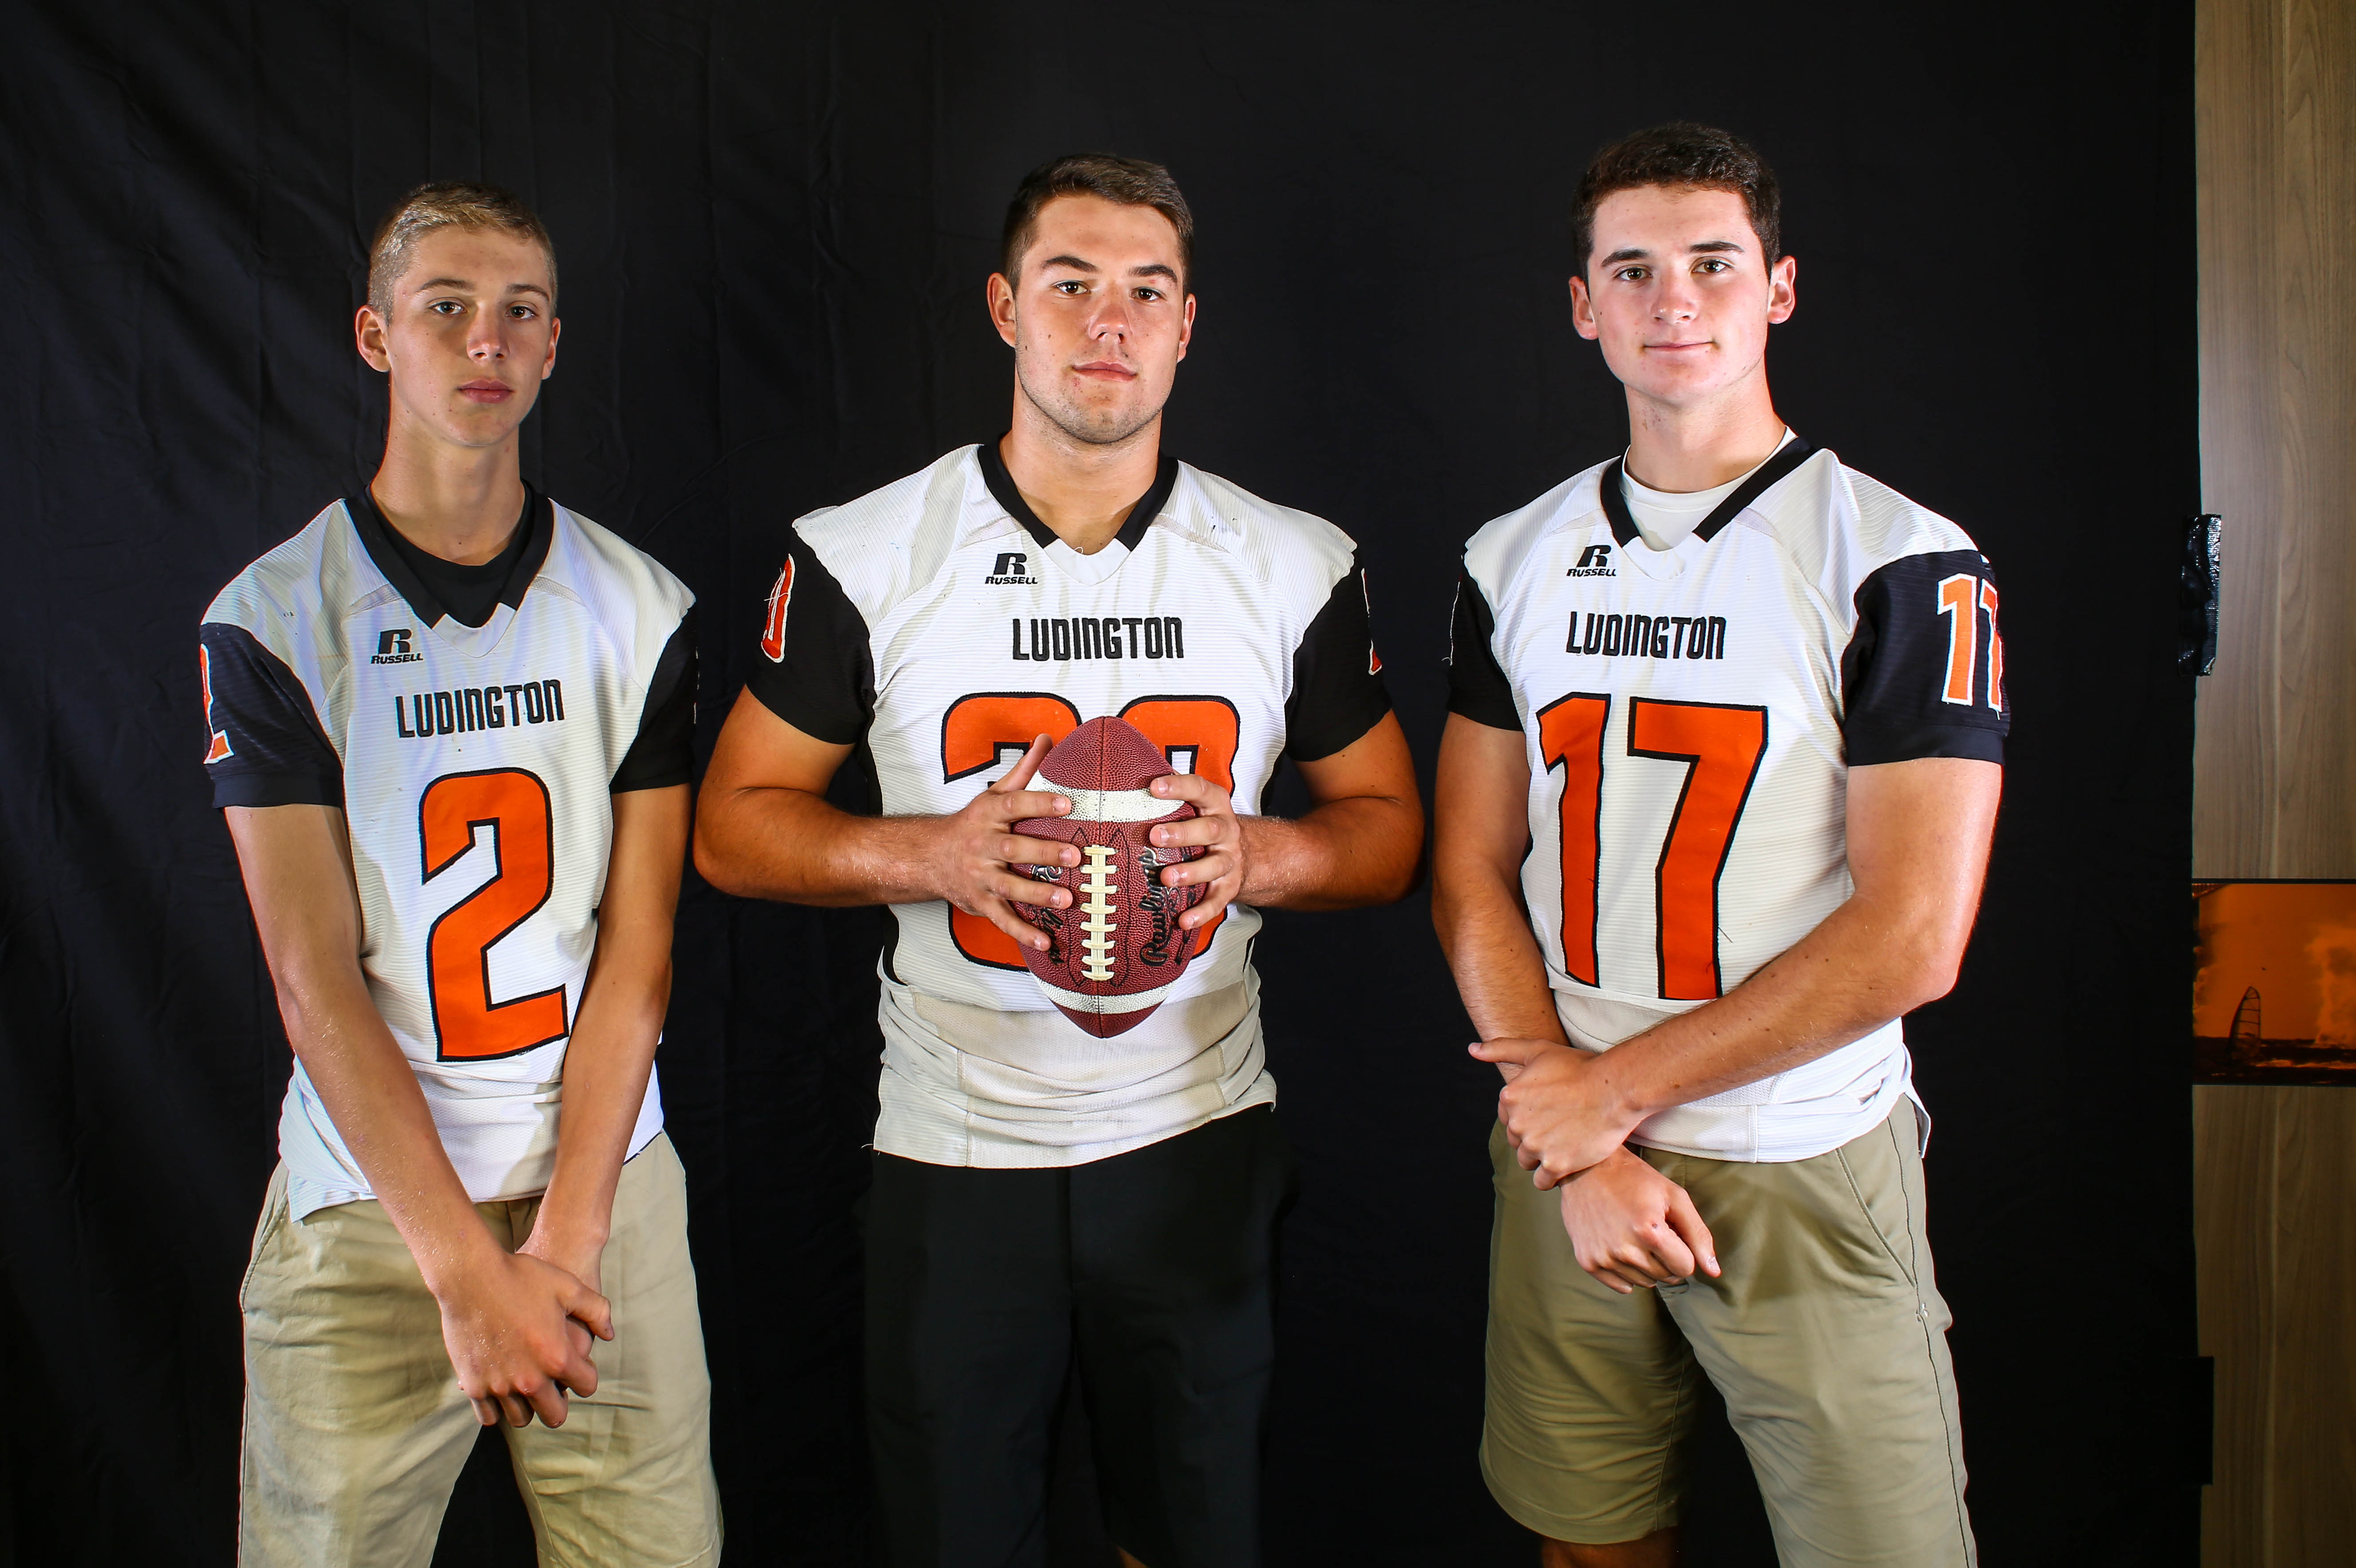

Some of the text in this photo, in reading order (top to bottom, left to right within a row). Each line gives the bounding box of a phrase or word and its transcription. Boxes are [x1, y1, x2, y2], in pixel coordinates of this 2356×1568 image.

[984, 576, 1038, 585] RUSSELL
[1566, 568, 1617, 577] RUSSELL
[371, 653, 424, 664] RUSSELL
[1012, 616, 1184, 661] LUDINGTON
[1565, 611, 1727, 660] LUDINGTON
[395, 679, 565, 738] LUDINGTON
[1536, 691, 1768, 1001] 17
[419, 767, 569, 1062] 2
